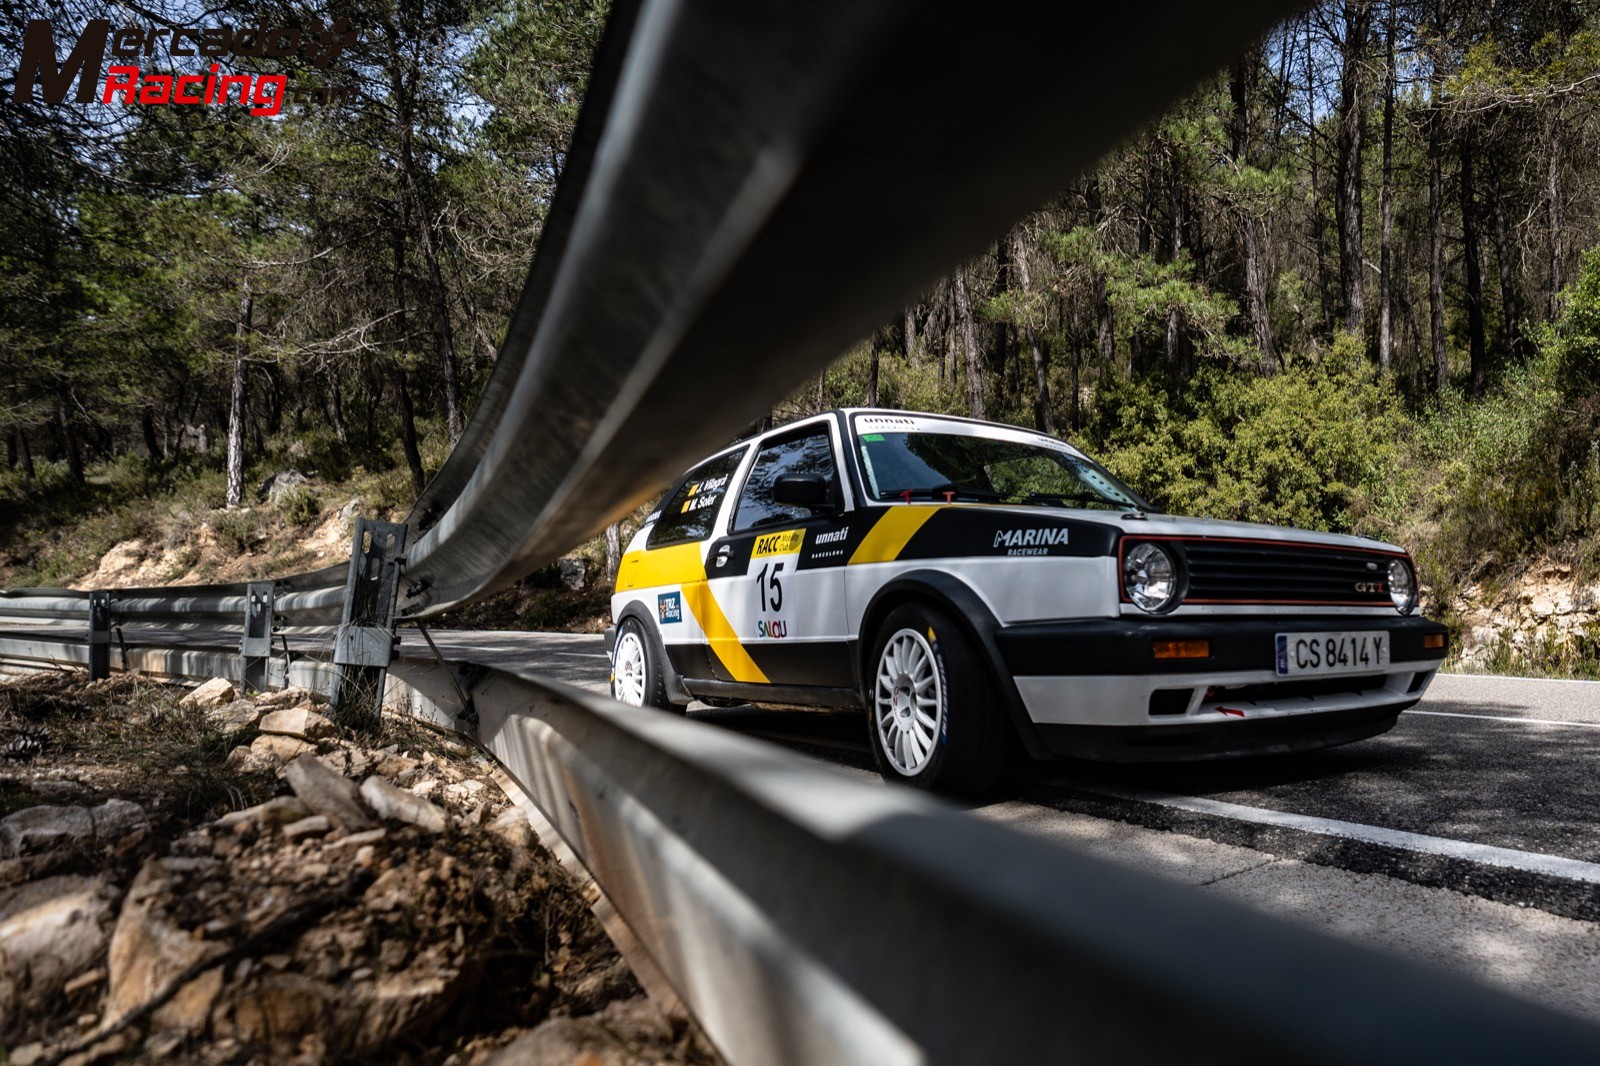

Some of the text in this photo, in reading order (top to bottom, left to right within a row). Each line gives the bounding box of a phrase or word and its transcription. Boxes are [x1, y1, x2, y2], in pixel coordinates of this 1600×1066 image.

[756, 535, 781, 555] RACC
[815, 526, 849, 545] unnati
[993, 528, 1069, 548] MARINA
[1007, 547, 1049, 556] RACEWEAR
[757, 562, 785, 612] 15
[1355, 582, 1383, 593] GTI
[757, 620, 787, 638] SALOU
